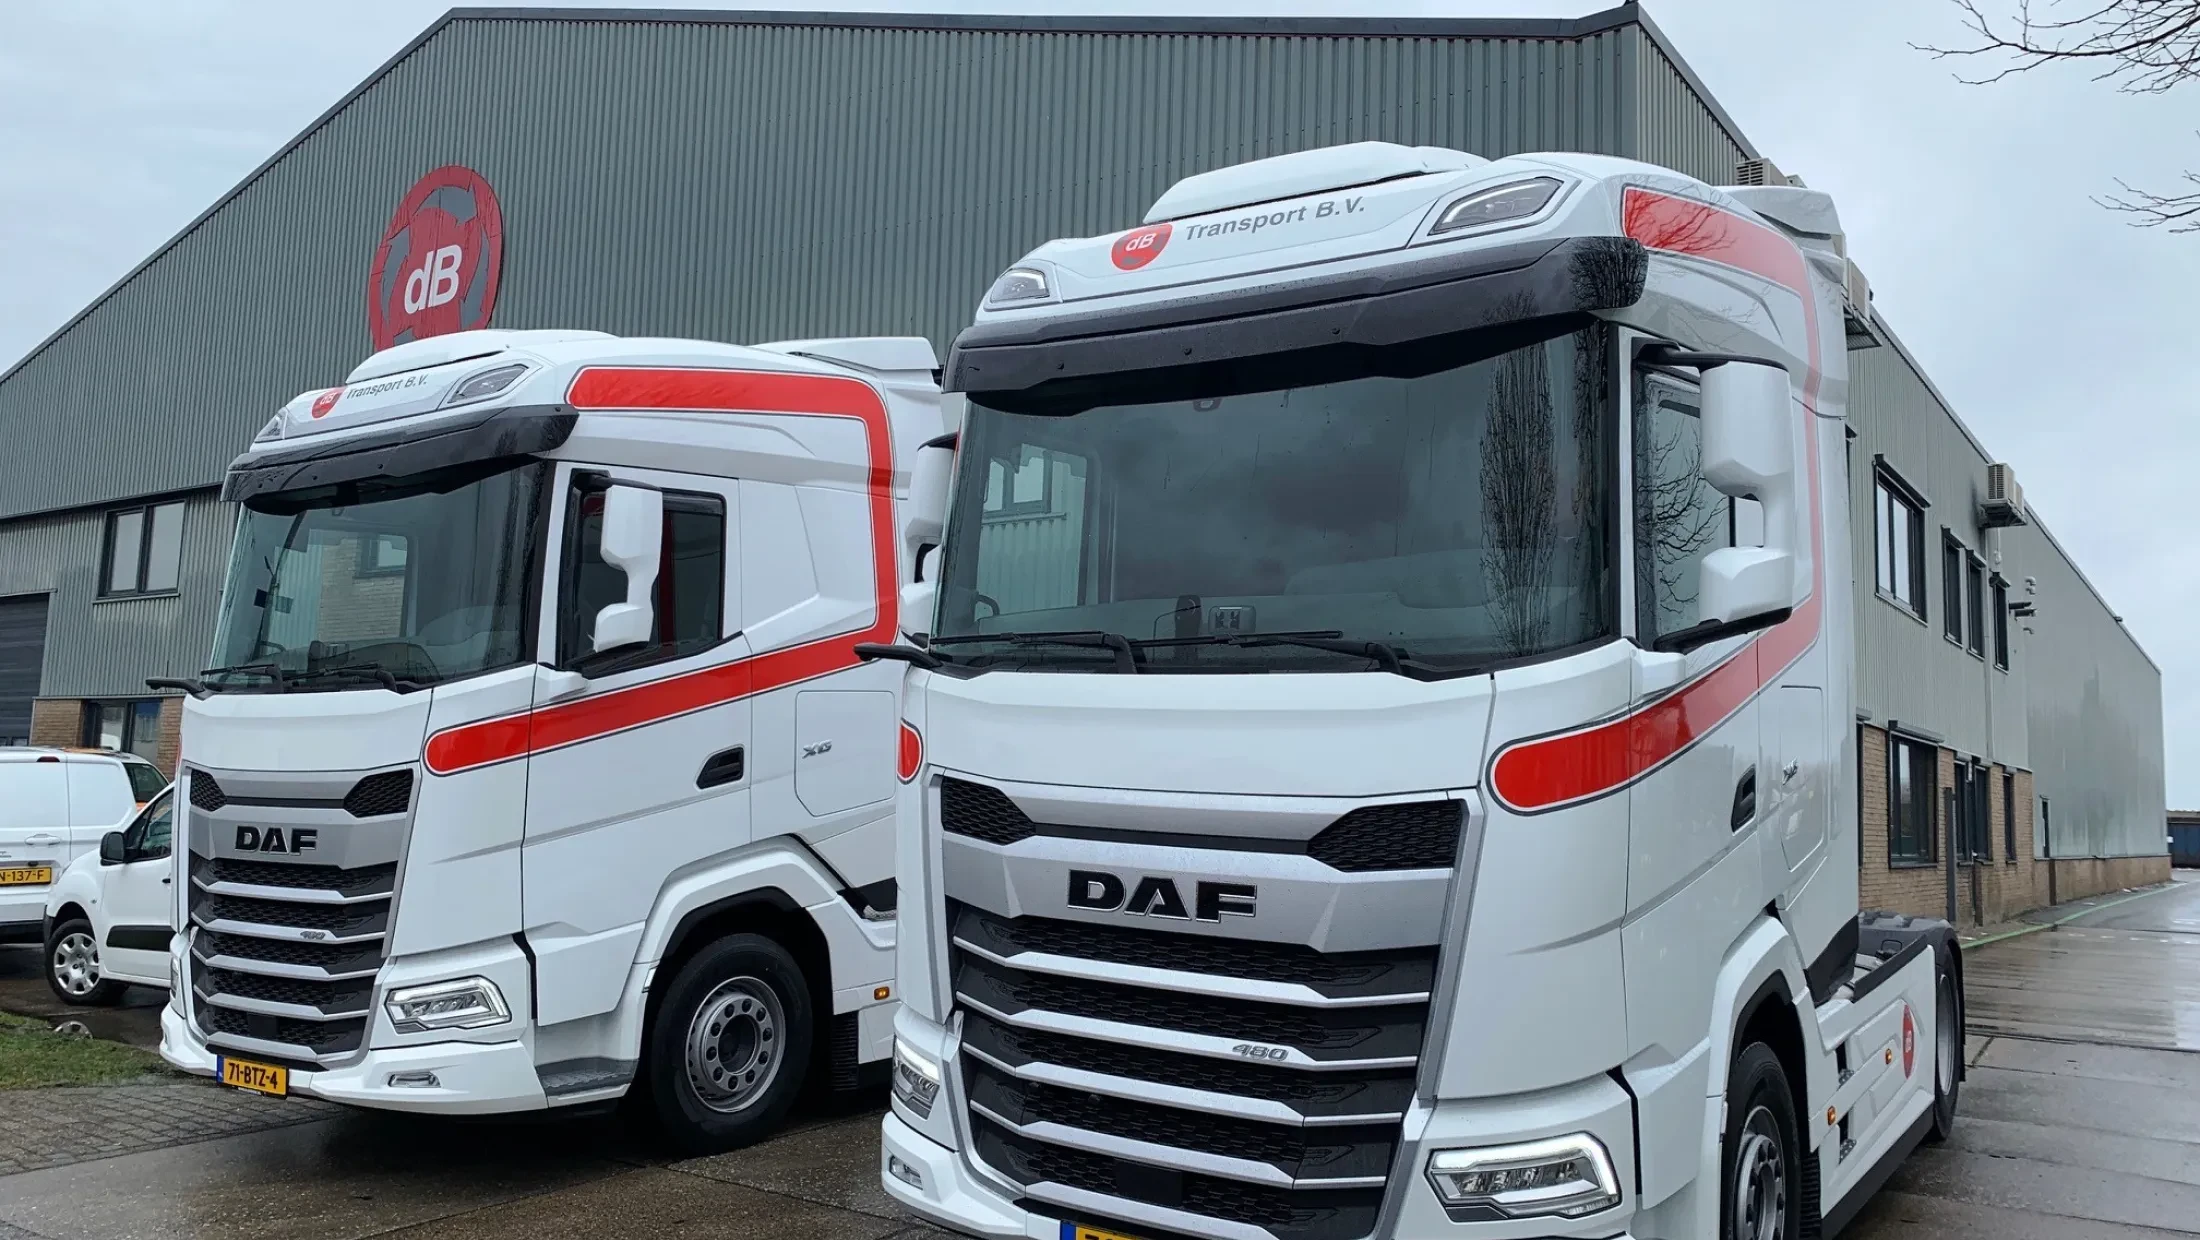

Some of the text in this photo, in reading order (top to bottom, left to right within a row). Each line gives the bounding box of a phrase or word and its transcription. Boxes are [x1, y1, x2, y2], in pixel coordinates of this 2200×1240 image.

[1186, 196, 1365, 241] Transport B.V.
[1125, 232, 1156, 252] dB
[404, 244, 462, 315] dB
[346, 374, 429, 400] Transport B.V.
[235, 825, 318, 856] DAF
[1067, 869, 1257, 924] DAF
[1232, 1044, 1290, 1061] 480
[228, 1062, 278, 1090] 71-BTZ-4
